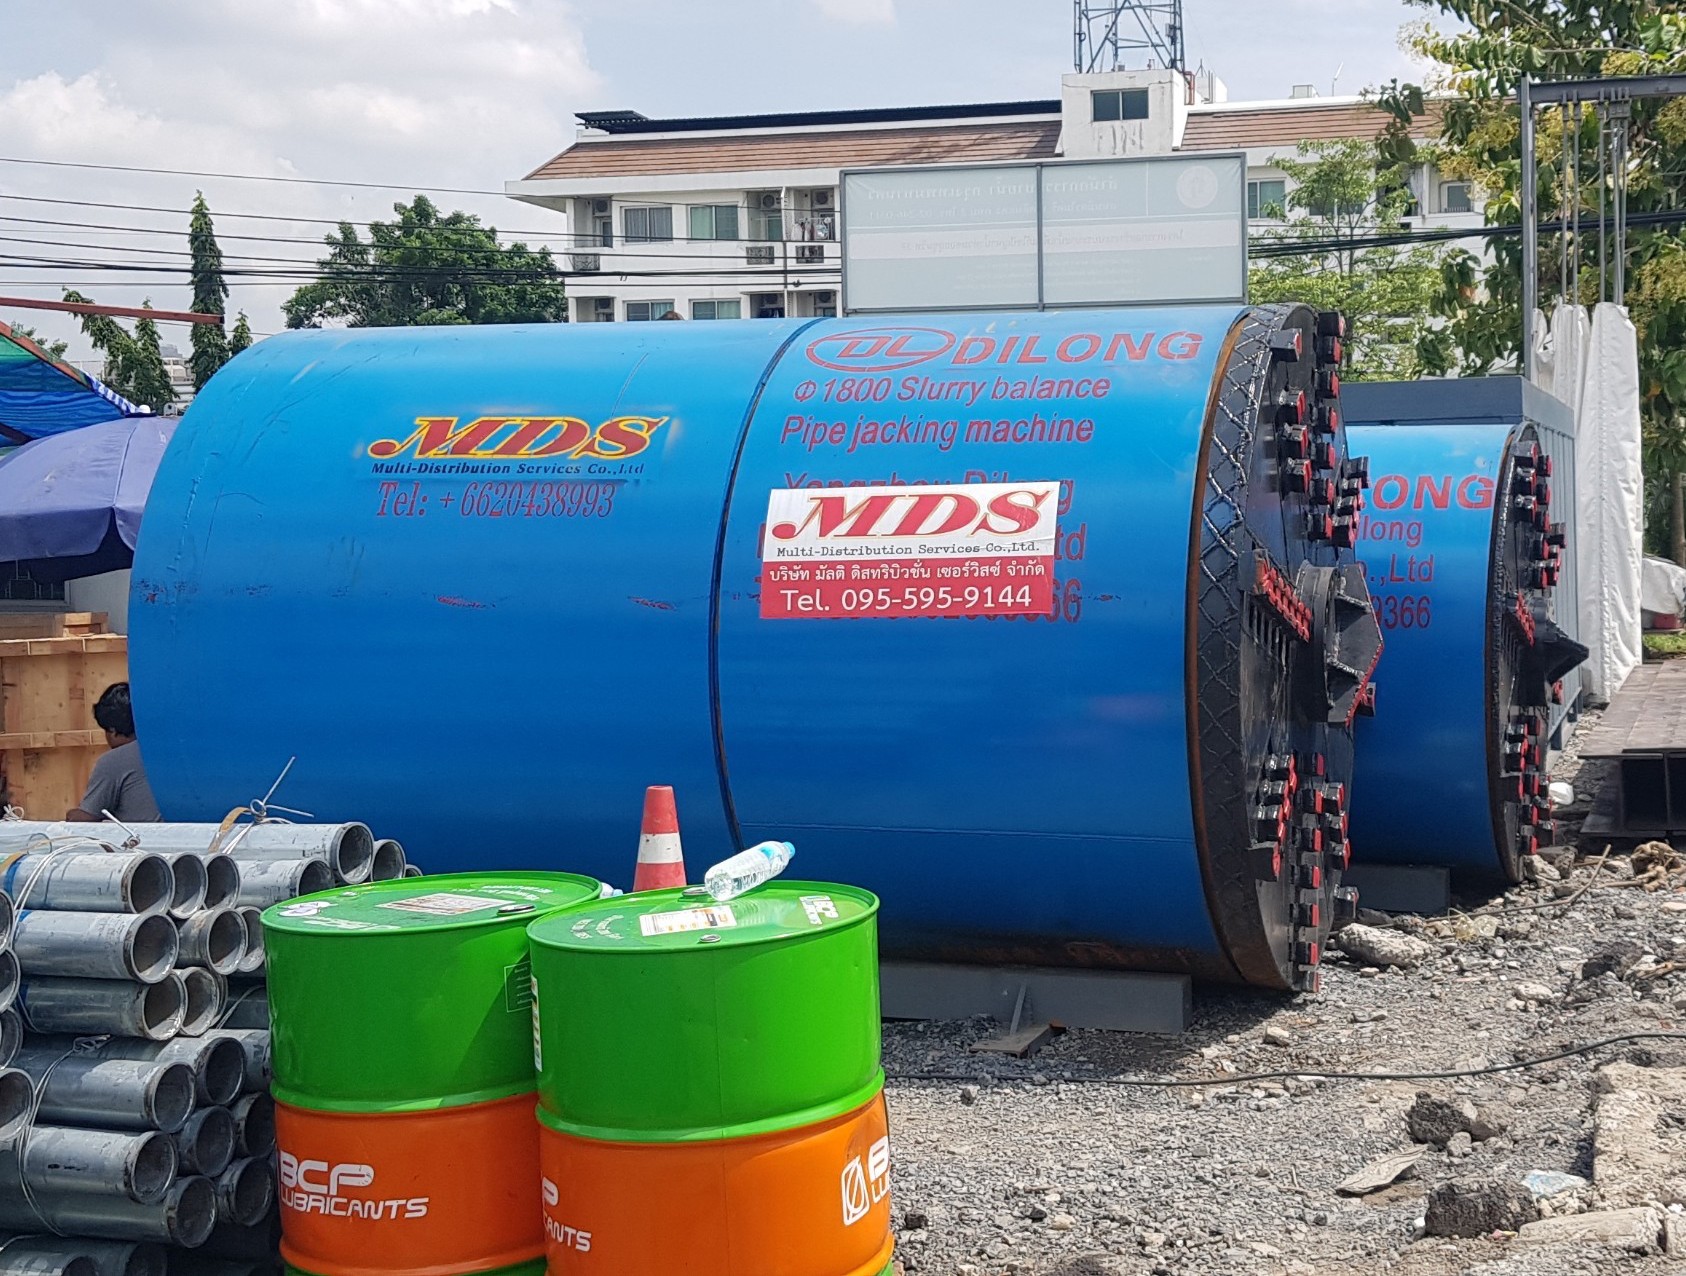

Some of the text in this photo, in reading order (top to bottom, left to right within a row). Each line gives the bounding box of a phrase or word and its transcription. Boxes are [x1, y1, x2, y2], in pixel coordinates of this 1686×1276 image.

[951, 331, 1204, 365] DILONG
[823, 377, 893, 402] 1800
[896, 375, 987, 407] Slurry
[991, 375, 1111, 399] balance
[367, 416, 670, 460] MDS
[780, 412, 1094, 453] Pipe jacking machine
[371, 462, 511, 475] Multi-Distribution
[516, 463, 582, 475] Services
[376, 481, 429, 517] Tel:
[1371, 474, 1496, 510] ONG
[771, 490, 1053, 540] MDS
[1356, 515, 1424, 549] long
[776, 542, 1040, 558] Multi-Distribution Services Co.,Ltd.
[769, 564, 810, 581] บริษัท
[815, 564, 845, 581] มัลติ
[1006, 559, 1045, 577] จำกัด
[780, 588, 830, 611] Tel.
[841, 584, 1032, 611] 095-595-9144
[280, 1150, 375, 1196] BCP
